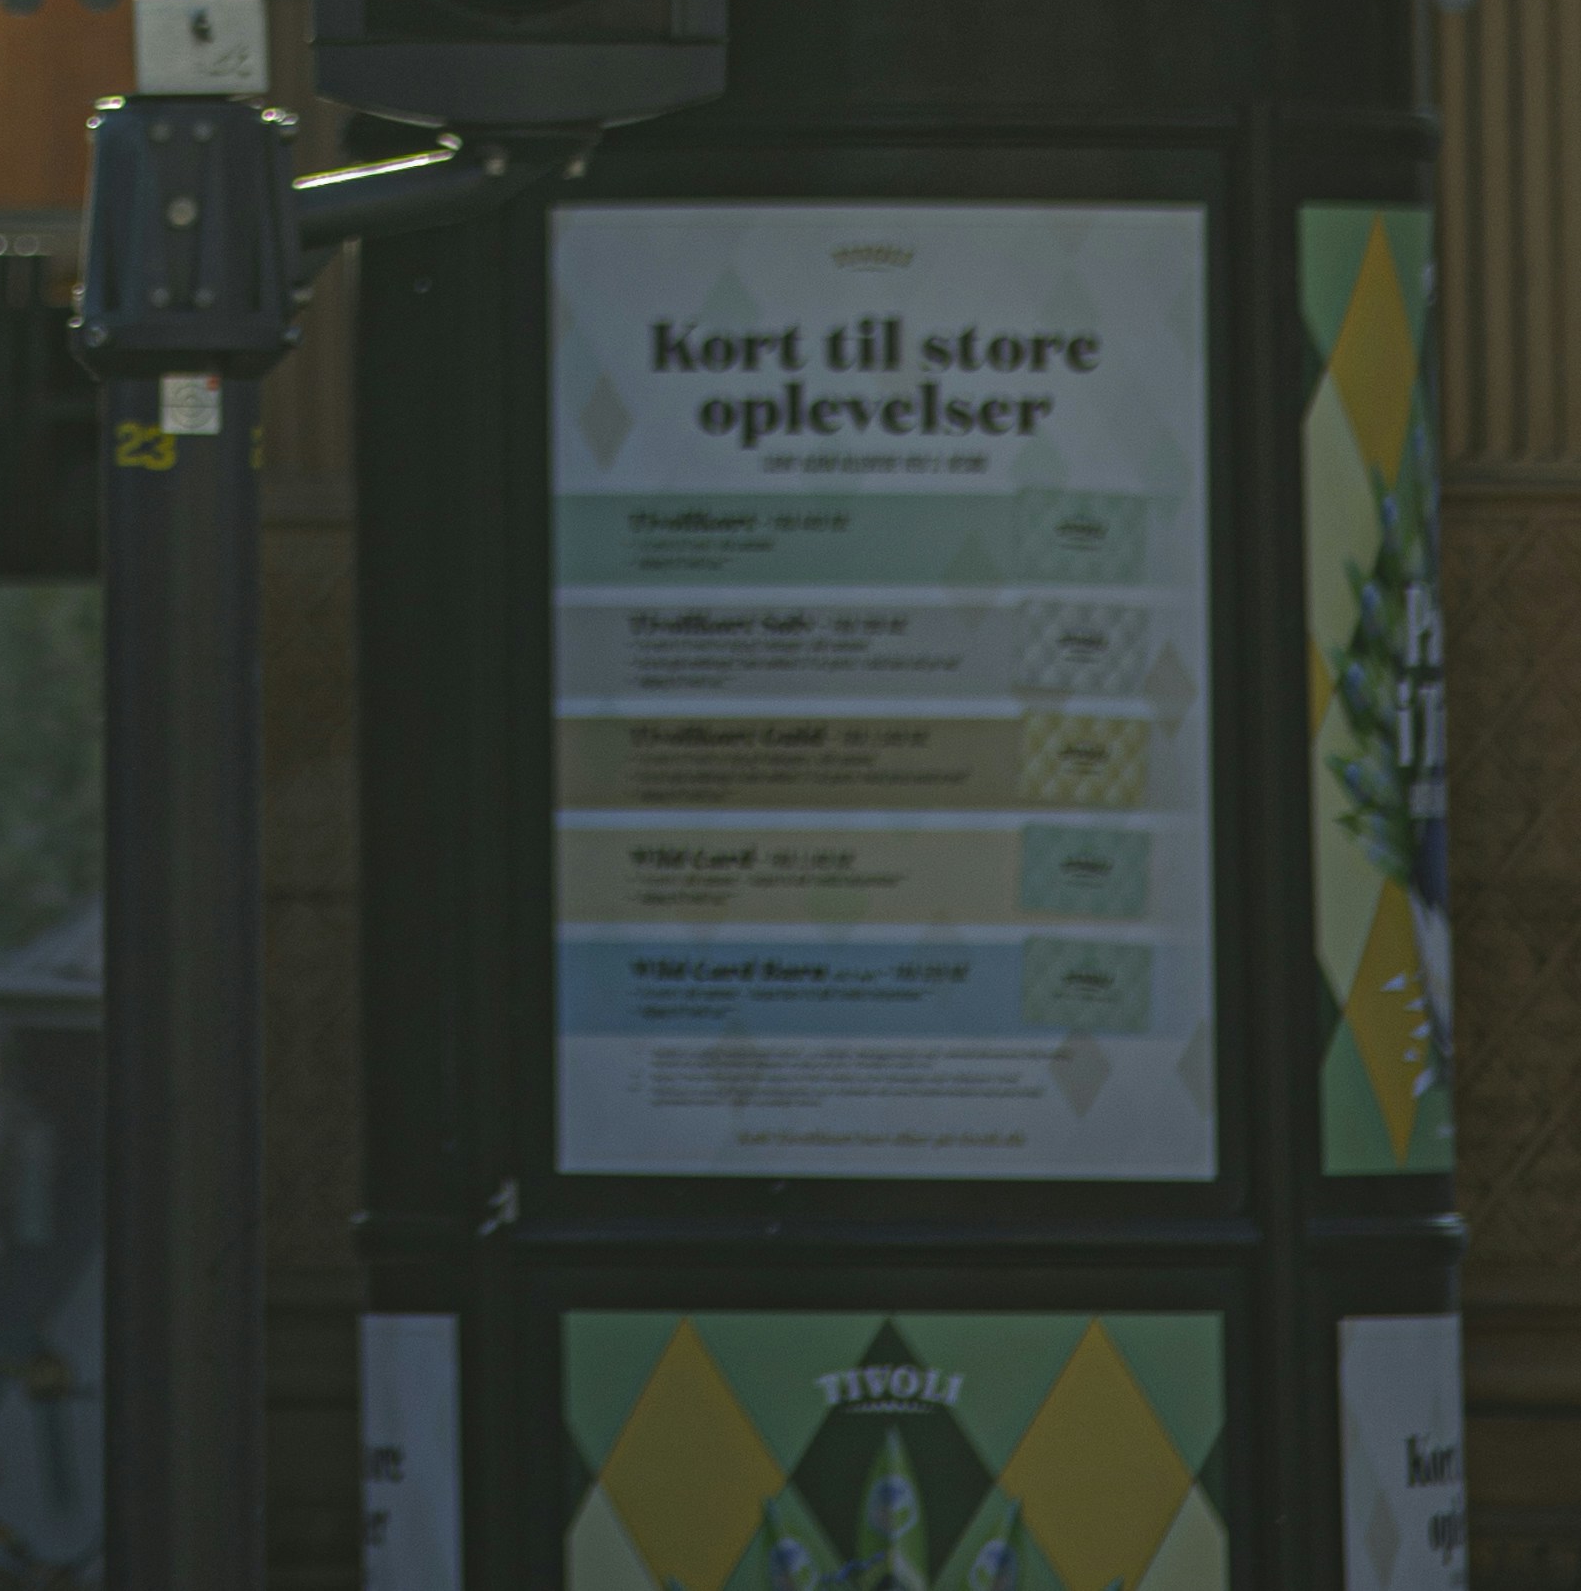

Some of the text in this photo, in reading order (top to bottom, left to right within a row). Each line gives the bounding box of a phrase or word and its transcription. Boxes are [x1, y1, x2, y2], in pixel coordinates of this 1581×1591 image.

[650, 314, 1101, 373] Kort til store
[697, 381, 1054, 448] oplevelser
[115, 421, 177, 471] 23
[817, 1365, 964, 1404] TIVOLI
